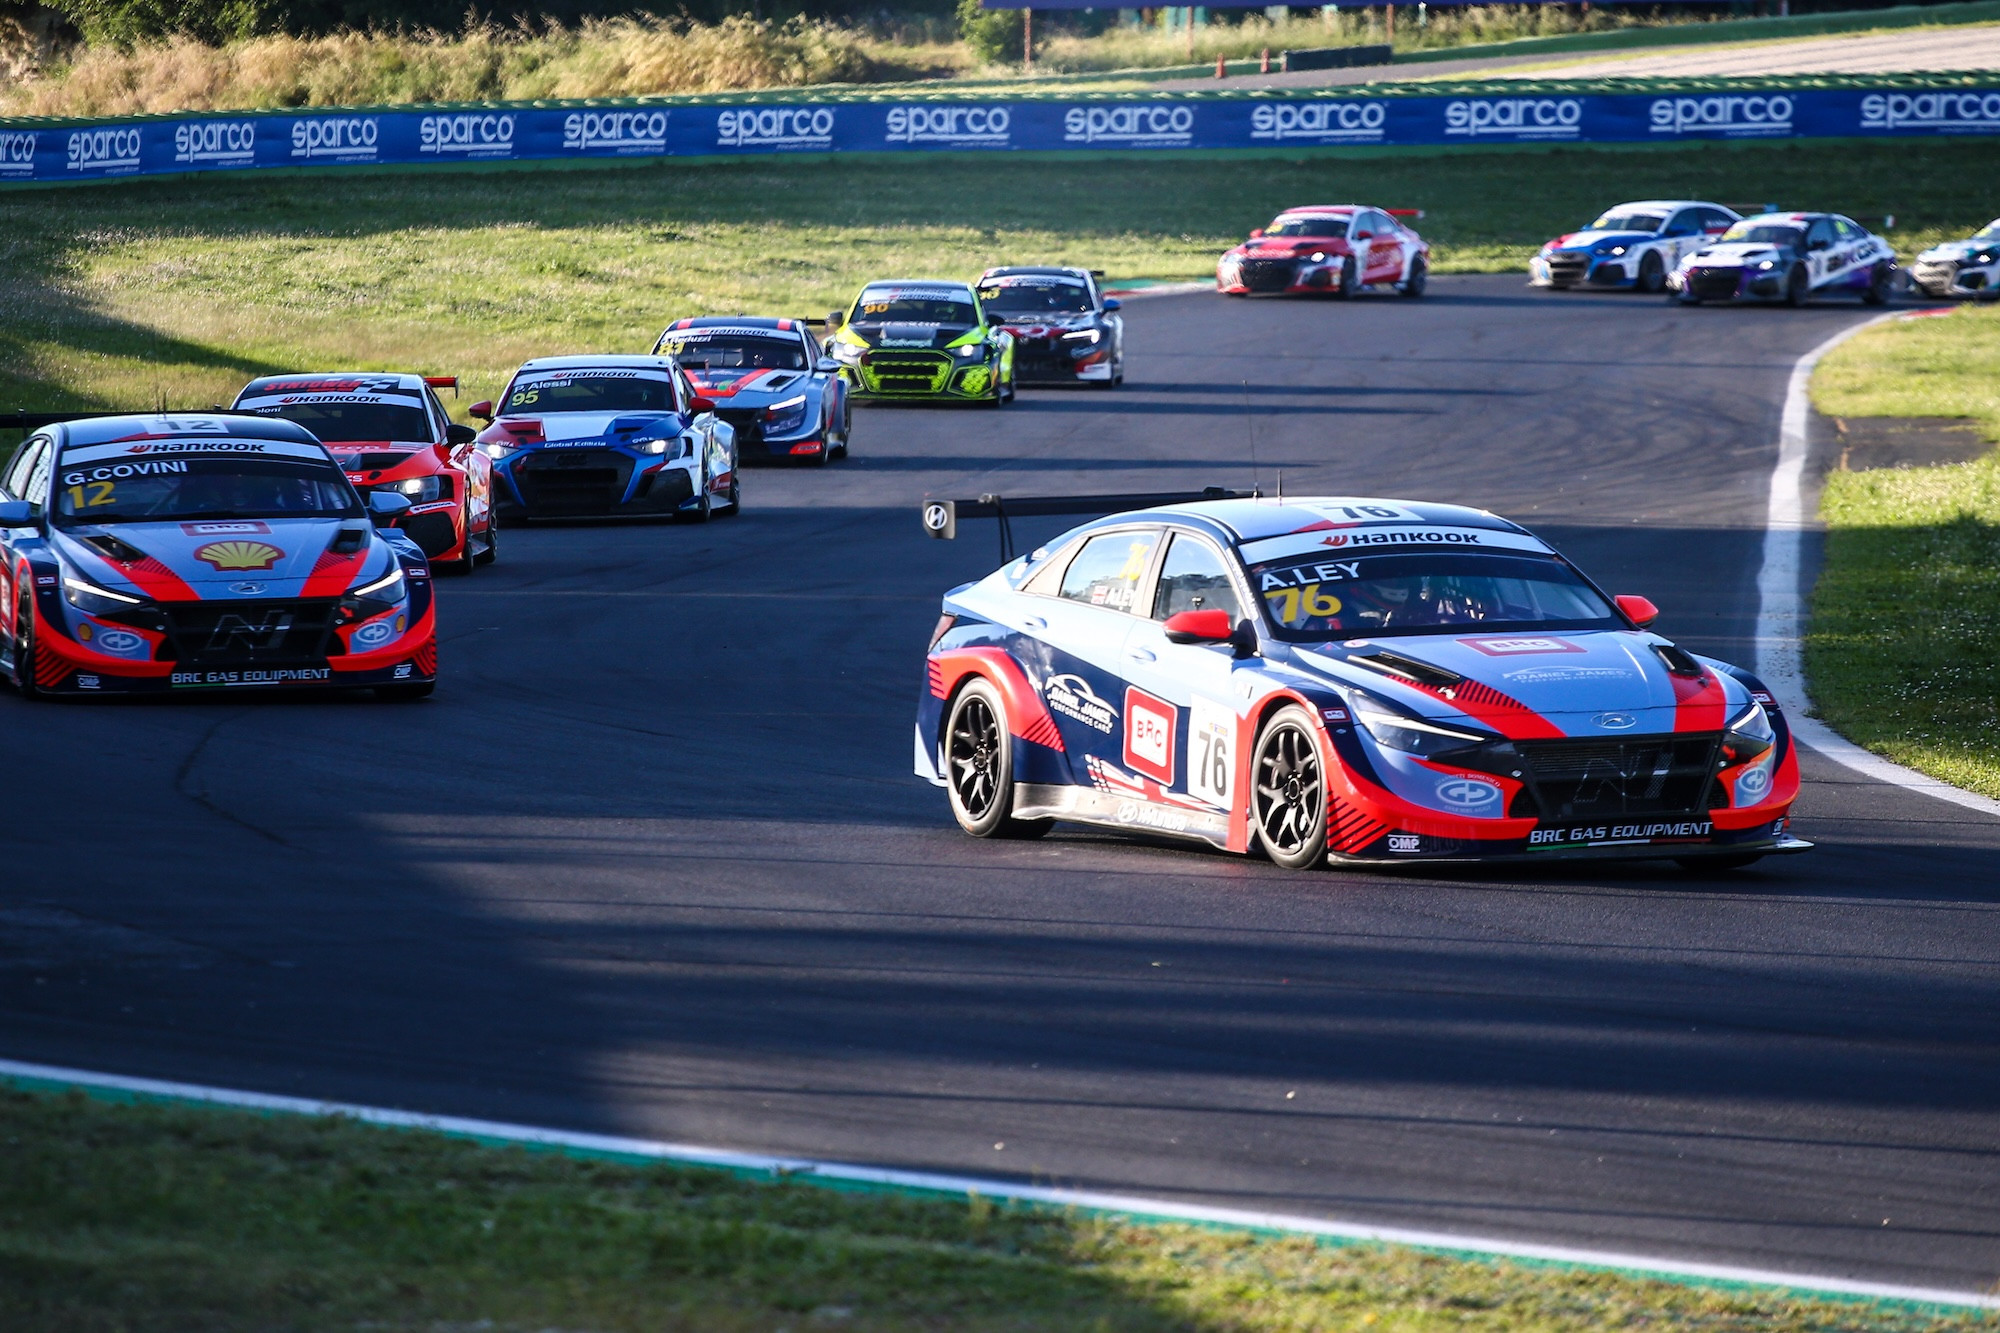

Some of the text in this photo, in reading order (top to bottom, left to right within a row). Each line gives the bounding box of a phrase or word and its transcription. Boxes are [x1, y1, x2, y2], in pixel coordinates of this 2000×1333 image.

[564, 112, 668, 149] sparco
[718, 108, 834, 145] sparco
[886, 106, 1010, 145] sparco
[1065, 105, 1194, 143] sparco
[1251, 103, 1385, 139] sparco
[1445, 99, 1582, 136] sparco
[1649, 96, 1794, 133] sparco
[0, 134, 36, 162] rco
[67, 129, 141, 171] sparco
[175, 123, 255, 163] sparco
[292, 118, 378, 158] sparco
[420, 115, 514, 154] sparco
[512, 390, 539, 407] 95
[528, 379, 572, 391] Alessi
[64, 460, 188, 486] G.COVINI
[67, 481, 117, 510] 12
[1322, 505, 1401, 519] 76
[1261, 561, 1360, 592] A.LEY
[1263, 583, 1343, 625] 76
[171, 668, 331, 684] BRC GAS EQUIPMENT
[1050, 700, 1112, 735] PERFORMANCE CARS
[1081, 700, 1112, 725] JAMES
[1137, 719, 1163, 748] BRC
[1198, 729, 1227, 797] 76
[1388, 837, 1420, 850] OMP
[1529, 822, 1714, 844] BRC GAS EQUIPMENT
